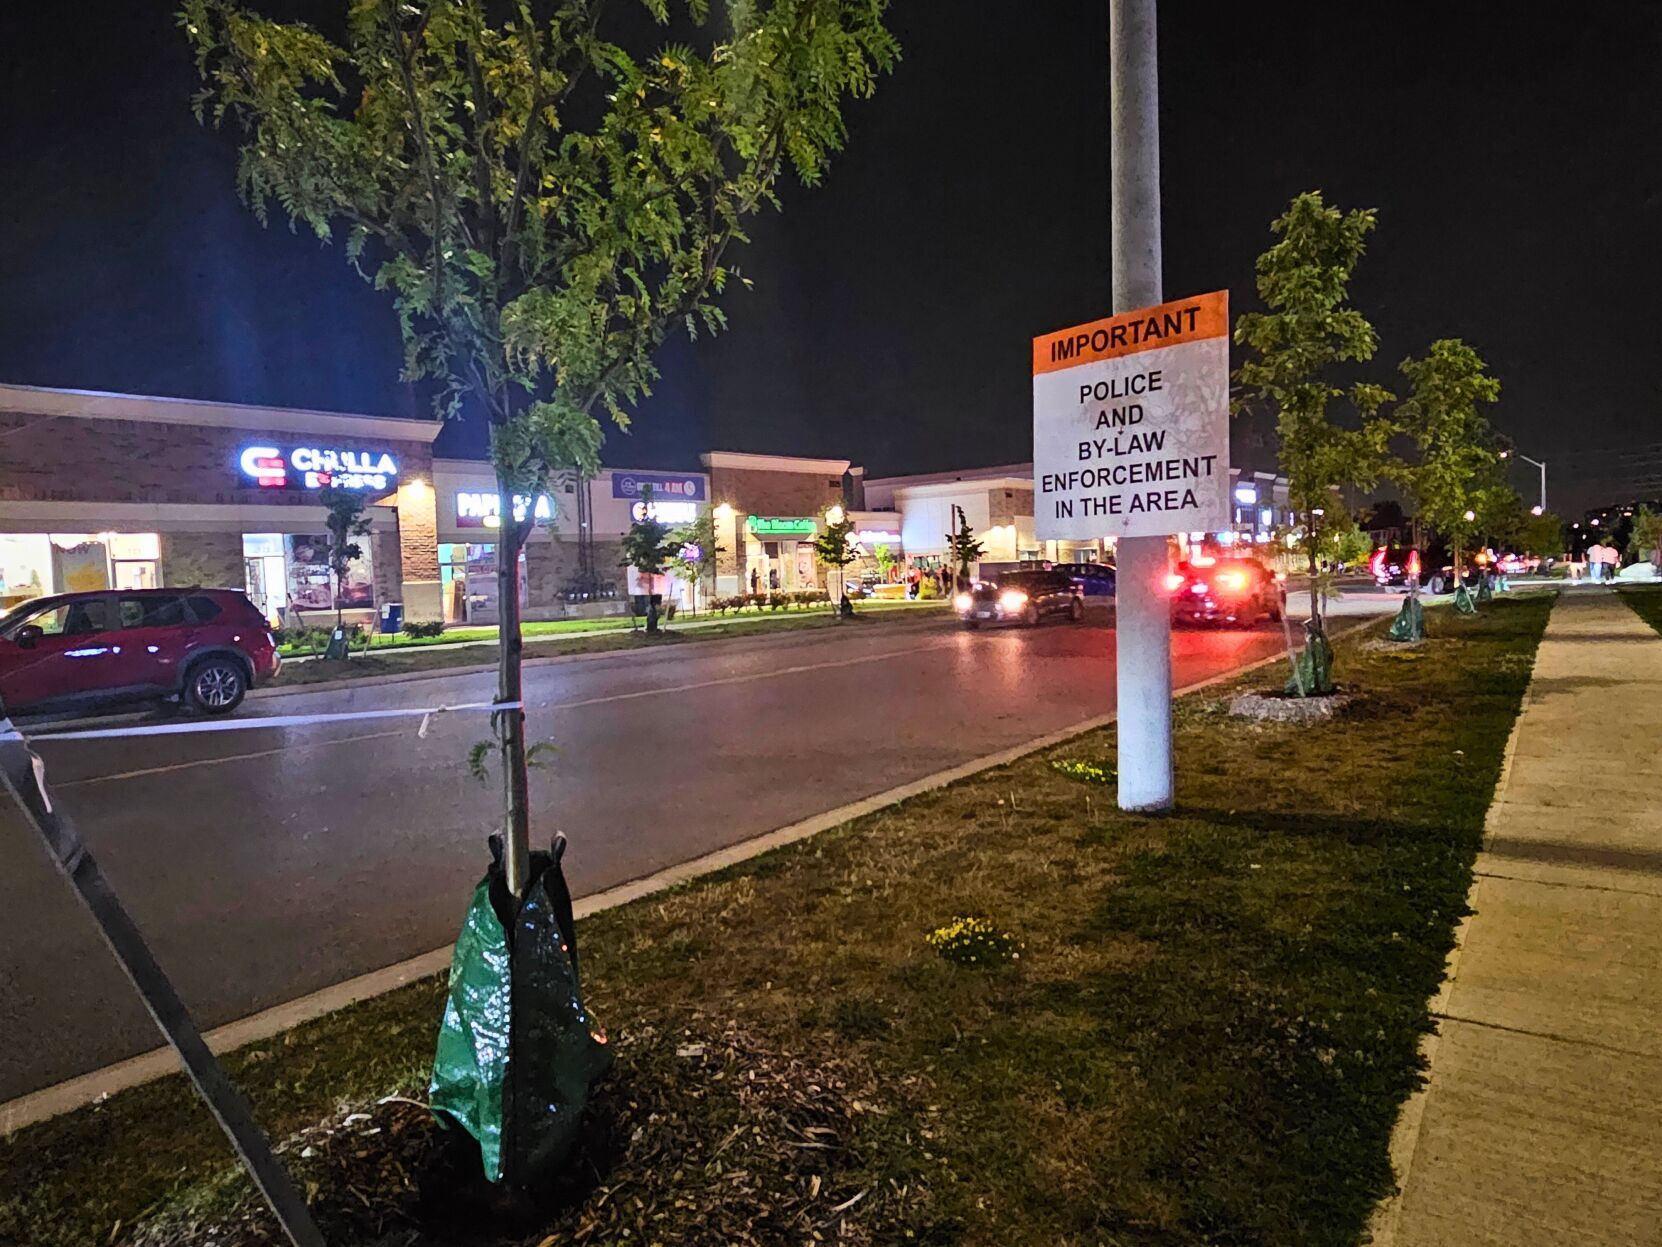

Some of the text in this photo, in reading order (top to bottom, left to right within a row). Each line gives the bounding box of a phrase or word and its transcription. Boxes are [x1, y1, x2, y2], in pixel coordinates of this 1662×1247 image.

[1051, 306, 1200, 362] IMPORTANT
[1080, 370, 1162, 404] POLICE
[1095, 404, 1144, 430] AND
[1078, 430, 1166, 461] BY-LAW
[1042, 455, 1217, 493] ENFORCEMENT
[1055, 489, 1199, 518] IN THE AREA
